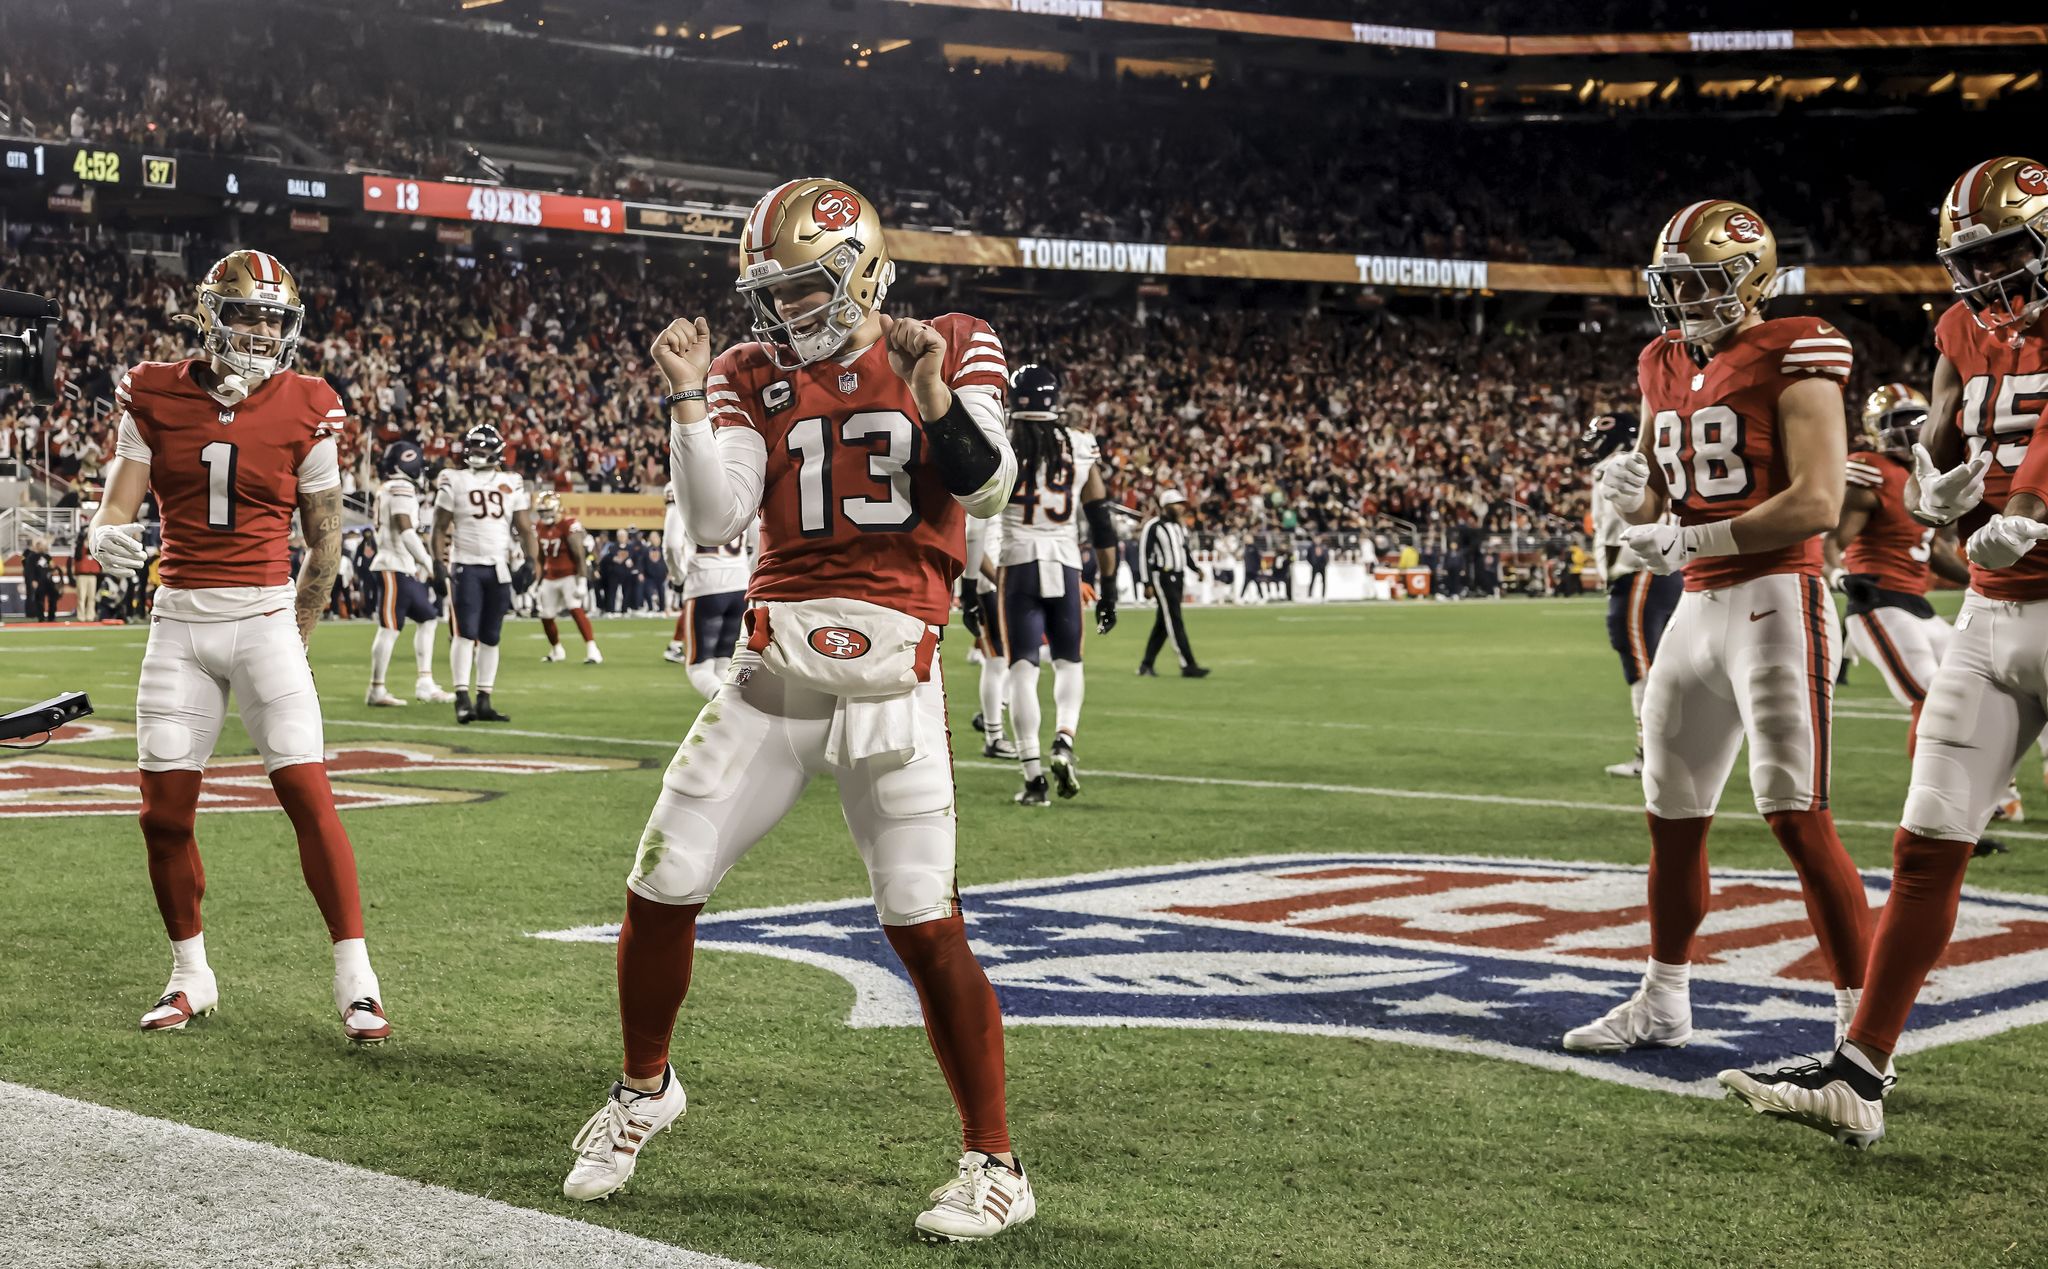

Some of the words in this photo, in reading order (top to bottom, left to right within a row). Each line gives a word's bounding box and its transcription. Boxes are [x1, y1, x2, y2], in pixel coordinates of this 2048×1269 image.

[1352, 22, 1436, 49] TOUCHDOWN
[1688, 29, 1794, 52] TOUCHDOWN
[34, 145, 44, 176] 1
[73, 149, 120, 183] 4:52
[149, 160, 170, 184] 37
[226, 173, 239, 194] &
[287, 178, 311, 197] BALL
[311, 181, 326, 198] ON
[396, 182, 420, 211] 13
[466, 186, 543, 226] 49ERS
[1018, 237, 1168, 274] TOUCHDOWN
[1355, 254, 1488, 289] TOUCHDOWN
[762, 380, 791, 408] C
[1962, 373, 2048, 472] 15
[1653, 405, 1754, 502] 88
[200, 441, 237, 531] 1
[787, 410, 921, 537] 13
[469, 489, 505, 519] 99
[320, 515, 339, 532] 48
[825, 630, 860, 656] SF
